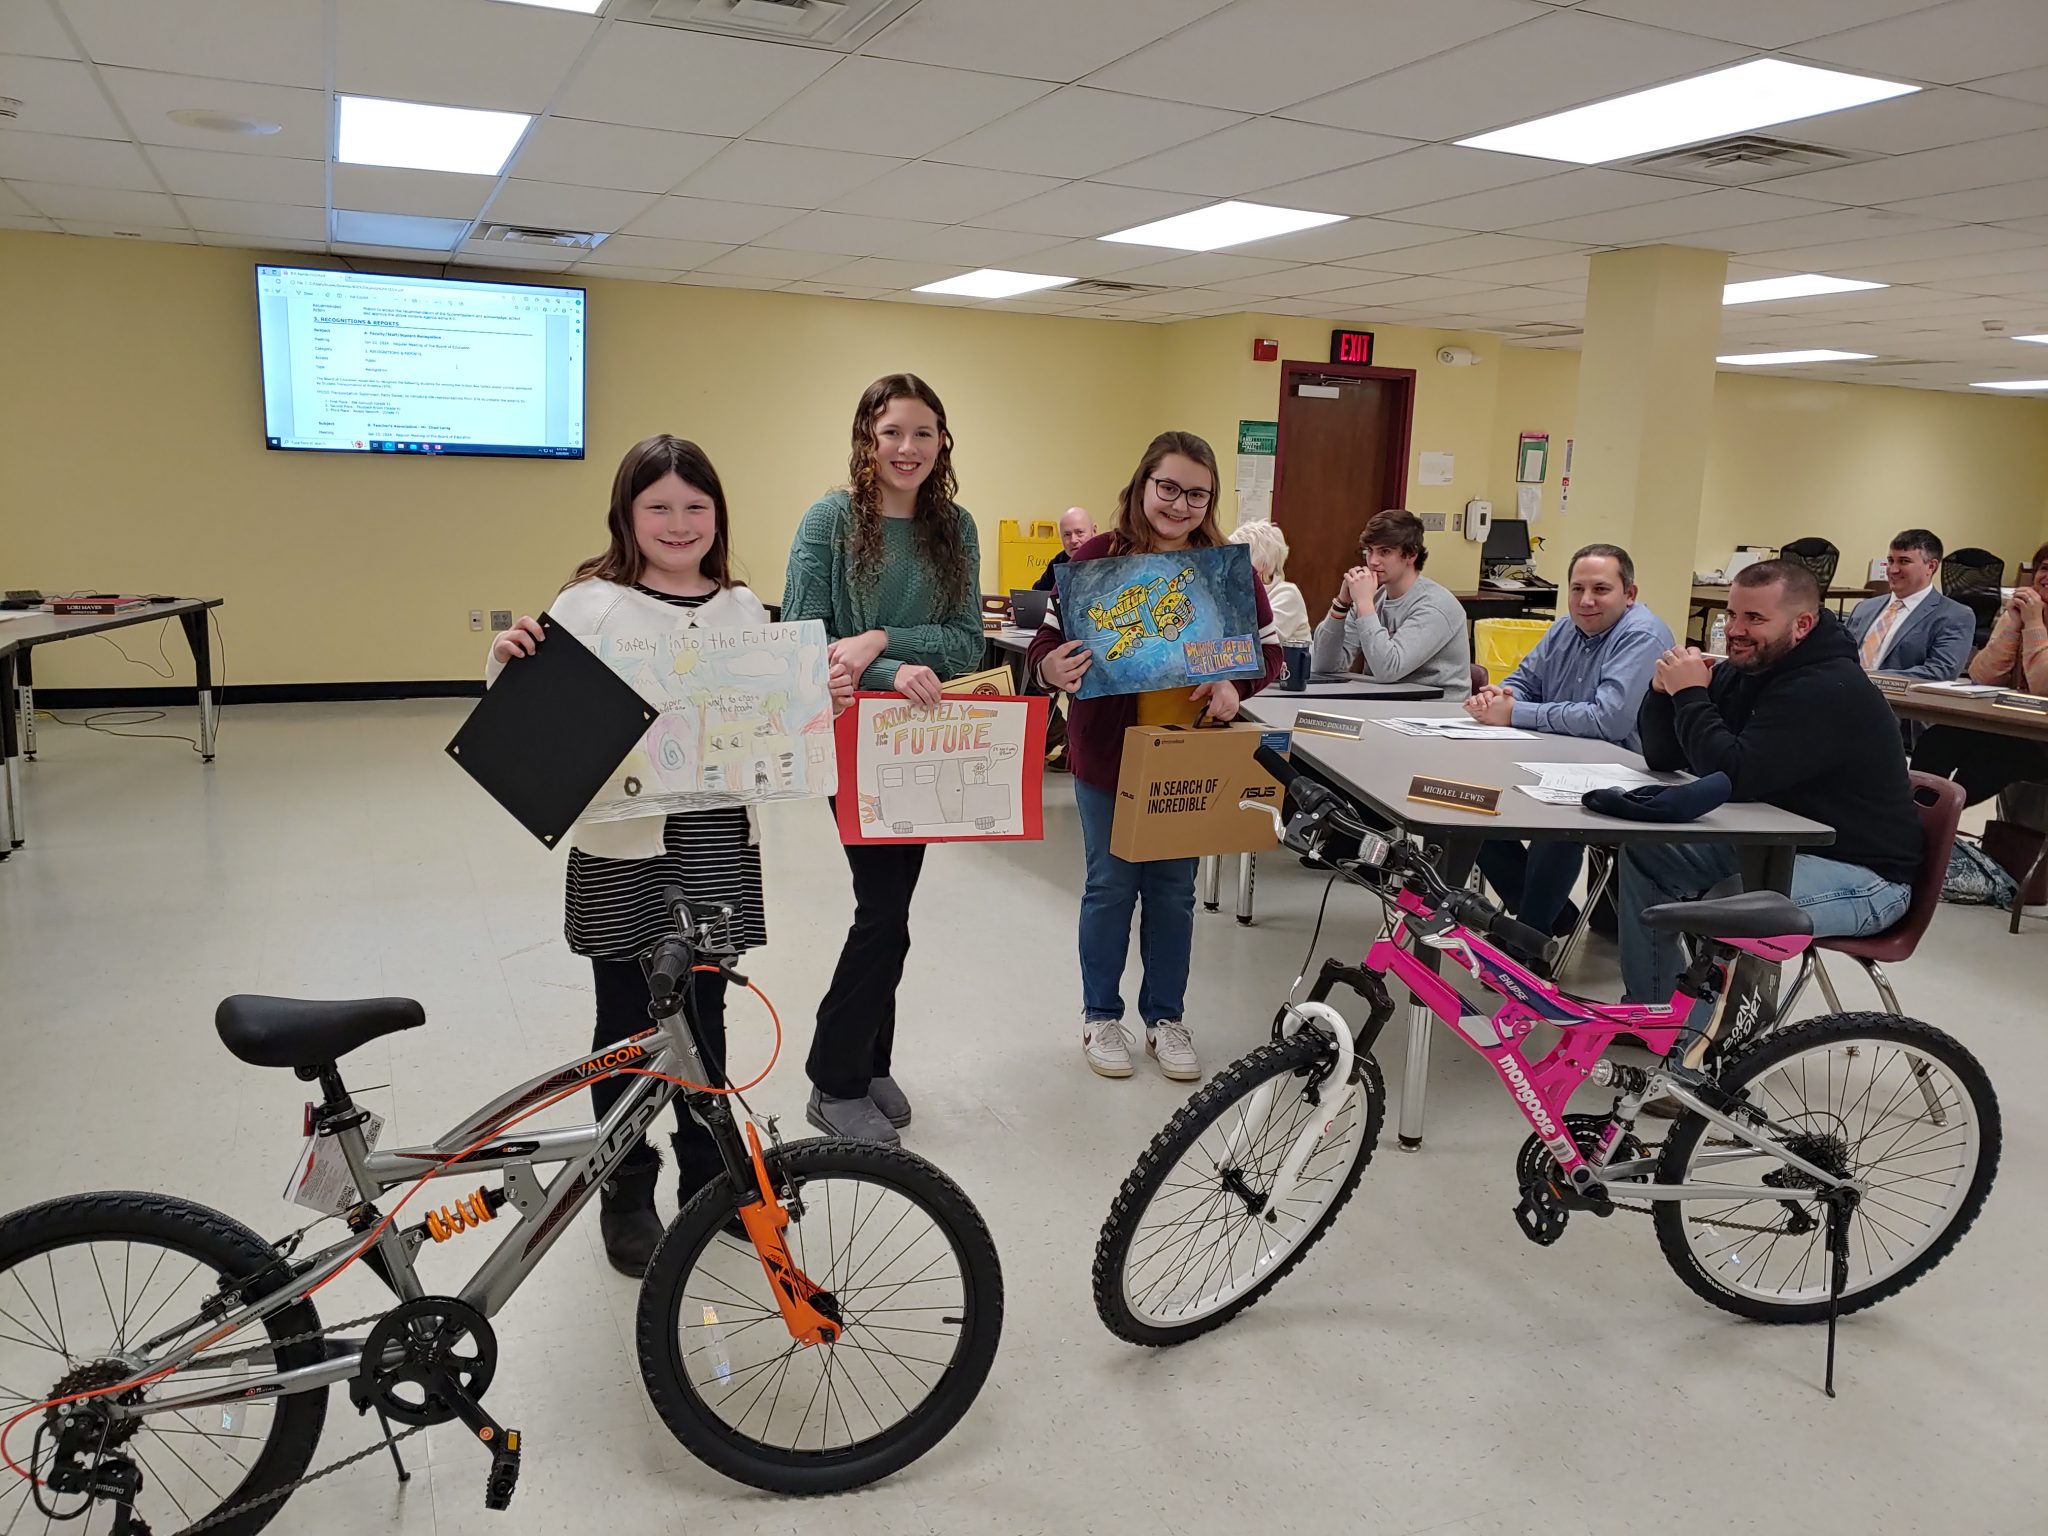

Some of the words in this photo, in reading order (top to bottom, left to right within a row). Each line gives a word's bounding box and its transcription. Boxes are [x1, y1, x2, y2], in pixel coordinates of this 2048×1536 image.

[1340, 333, 1370, 362] EXIT
[669, 634, 700, 649] into
[708, 633, 735, 648] the
[742, 629, 798, 644] Future
[894, 723, 992, 755] FUTURE
[1150, 781, 1161, 797] IN
[1163, 780, 1202, 796] SEARCH
[1204, 779, 1219, 794] OF
[1239, 786, 1277, 799] ASUS
[1423, 785, 1457, 798] MICHAEL
[1459, 791, 1486, 803] LEWIS
[1147, 796, 1208, 815] INCREDIBLE
[1722, 993, 1751, 1052] BORN
[1742, 985, 1763, 1037] DIRT
[1733, 1031, 1744, 1046] IN
[575, 1045, 642, 1078] VALCON
[1498, 1053, 1556, 1139] mongoose
[582, 1080, 669, 1185] HUFFY
